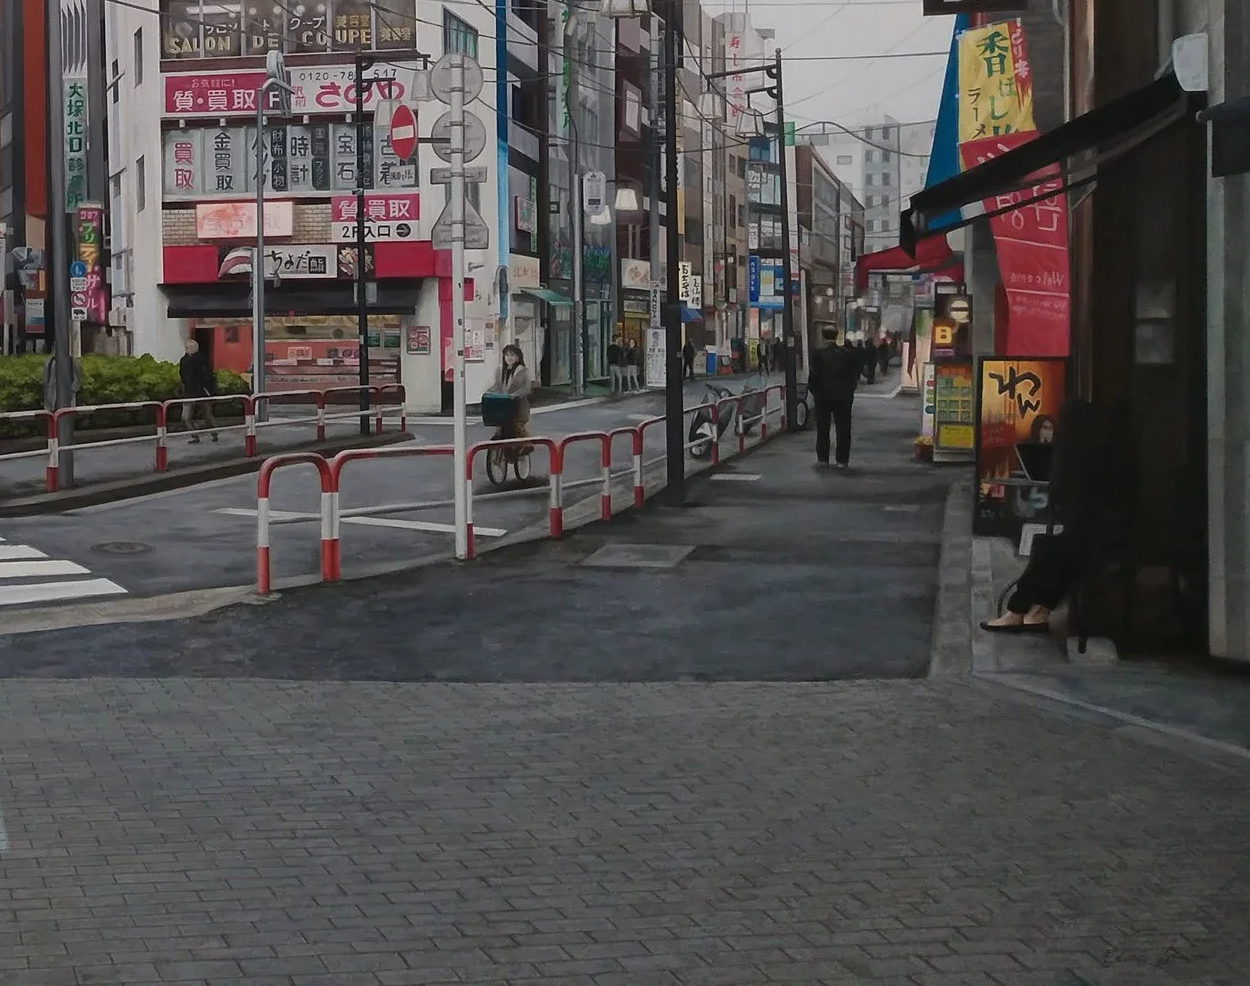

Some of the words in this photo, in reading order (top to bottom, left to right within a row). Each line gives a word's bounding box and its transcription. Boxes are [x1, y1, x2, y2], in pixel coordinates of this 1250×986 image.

[169, 36, 232, 55] SALON
[252, 32, 280, 49] DE
[301, 28, 372, 48] COUPE
[173, 89, 256, 113] 質・買取
[314, 81, 406, 109] さのや
[66, 81, 85, 208] 大塚北口診療所
[174, 142, 194, 190] 買取
[213, 131, 235, 192] 金買取
[271, 129, 284, 156] 財布
[290, 135, 309, 184] 時計
[337, 132, 356, 182] 宝石
[988, 365, 1042, 419] わん
